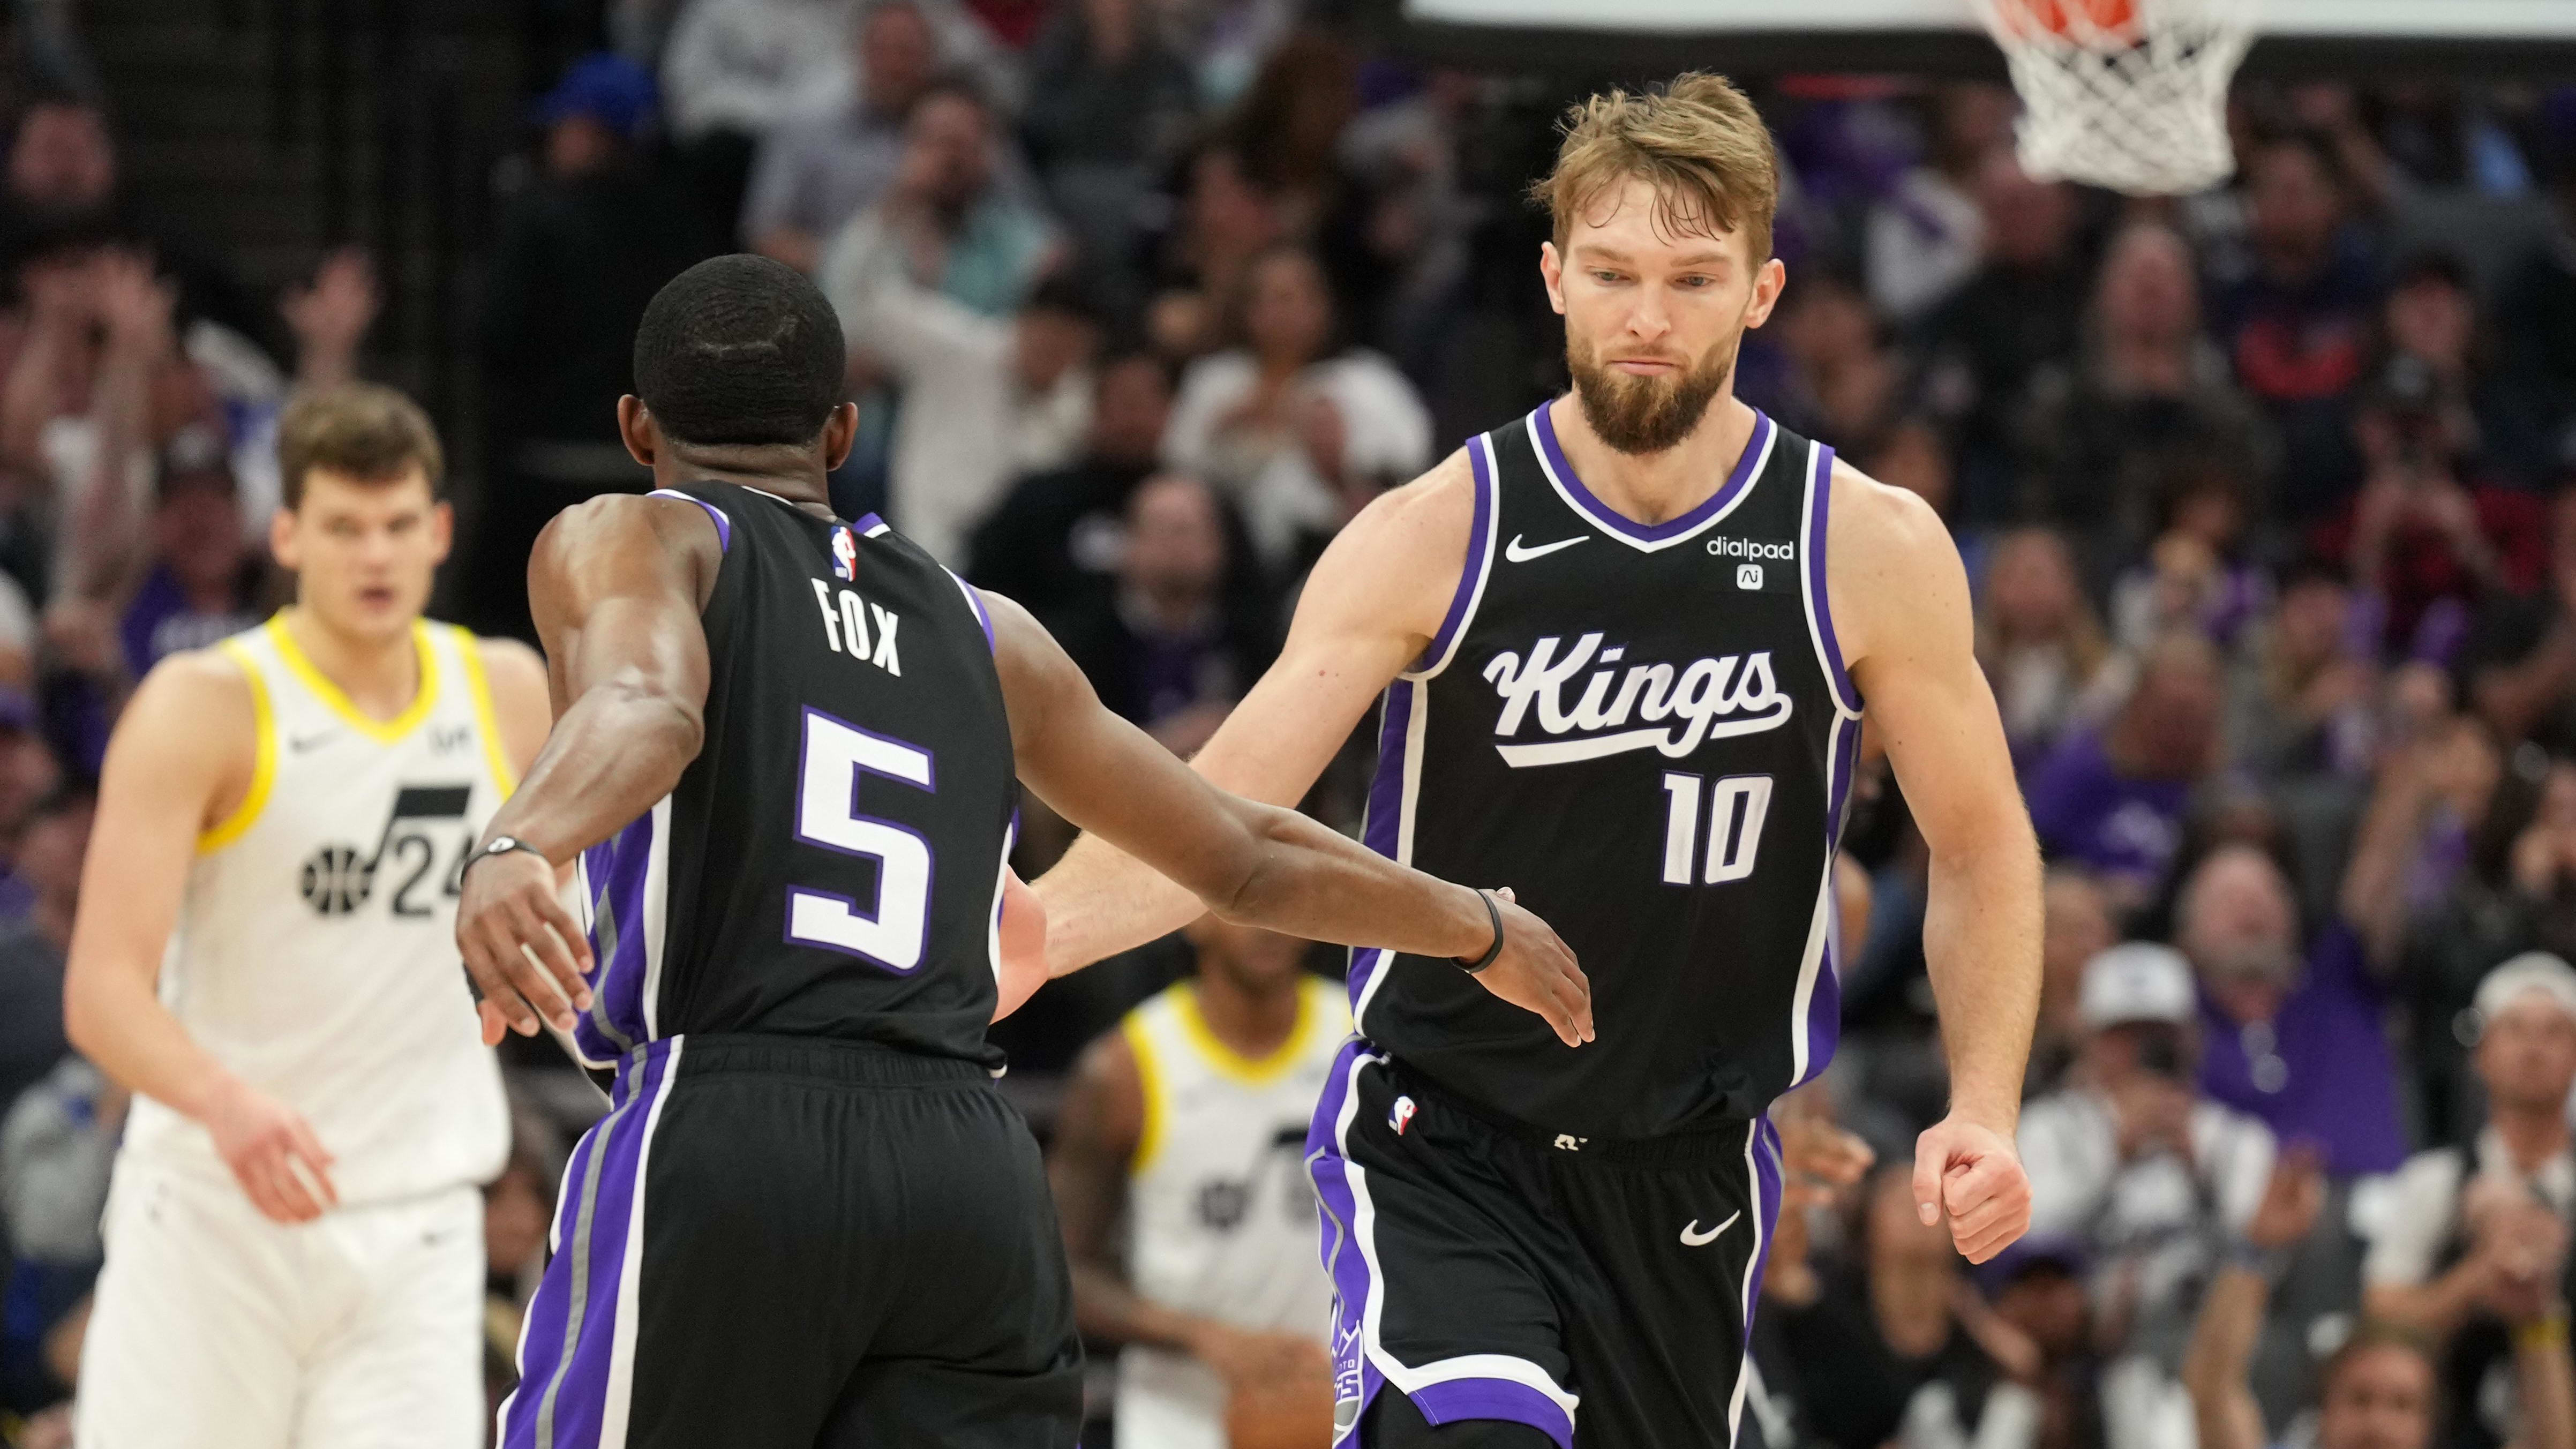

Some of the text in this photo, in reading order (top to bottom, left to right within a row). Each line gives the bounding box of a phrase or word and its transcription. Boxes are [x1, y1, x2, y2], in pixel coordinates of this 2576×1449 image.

[1706, 536, 1794, 561] dialpad
[811, 577, 901, 677] FOX
[1482, 631, 1793, 768] Kings
[783, 704, 936, 977] 5
[1662, 770, 1774, 886] 10
